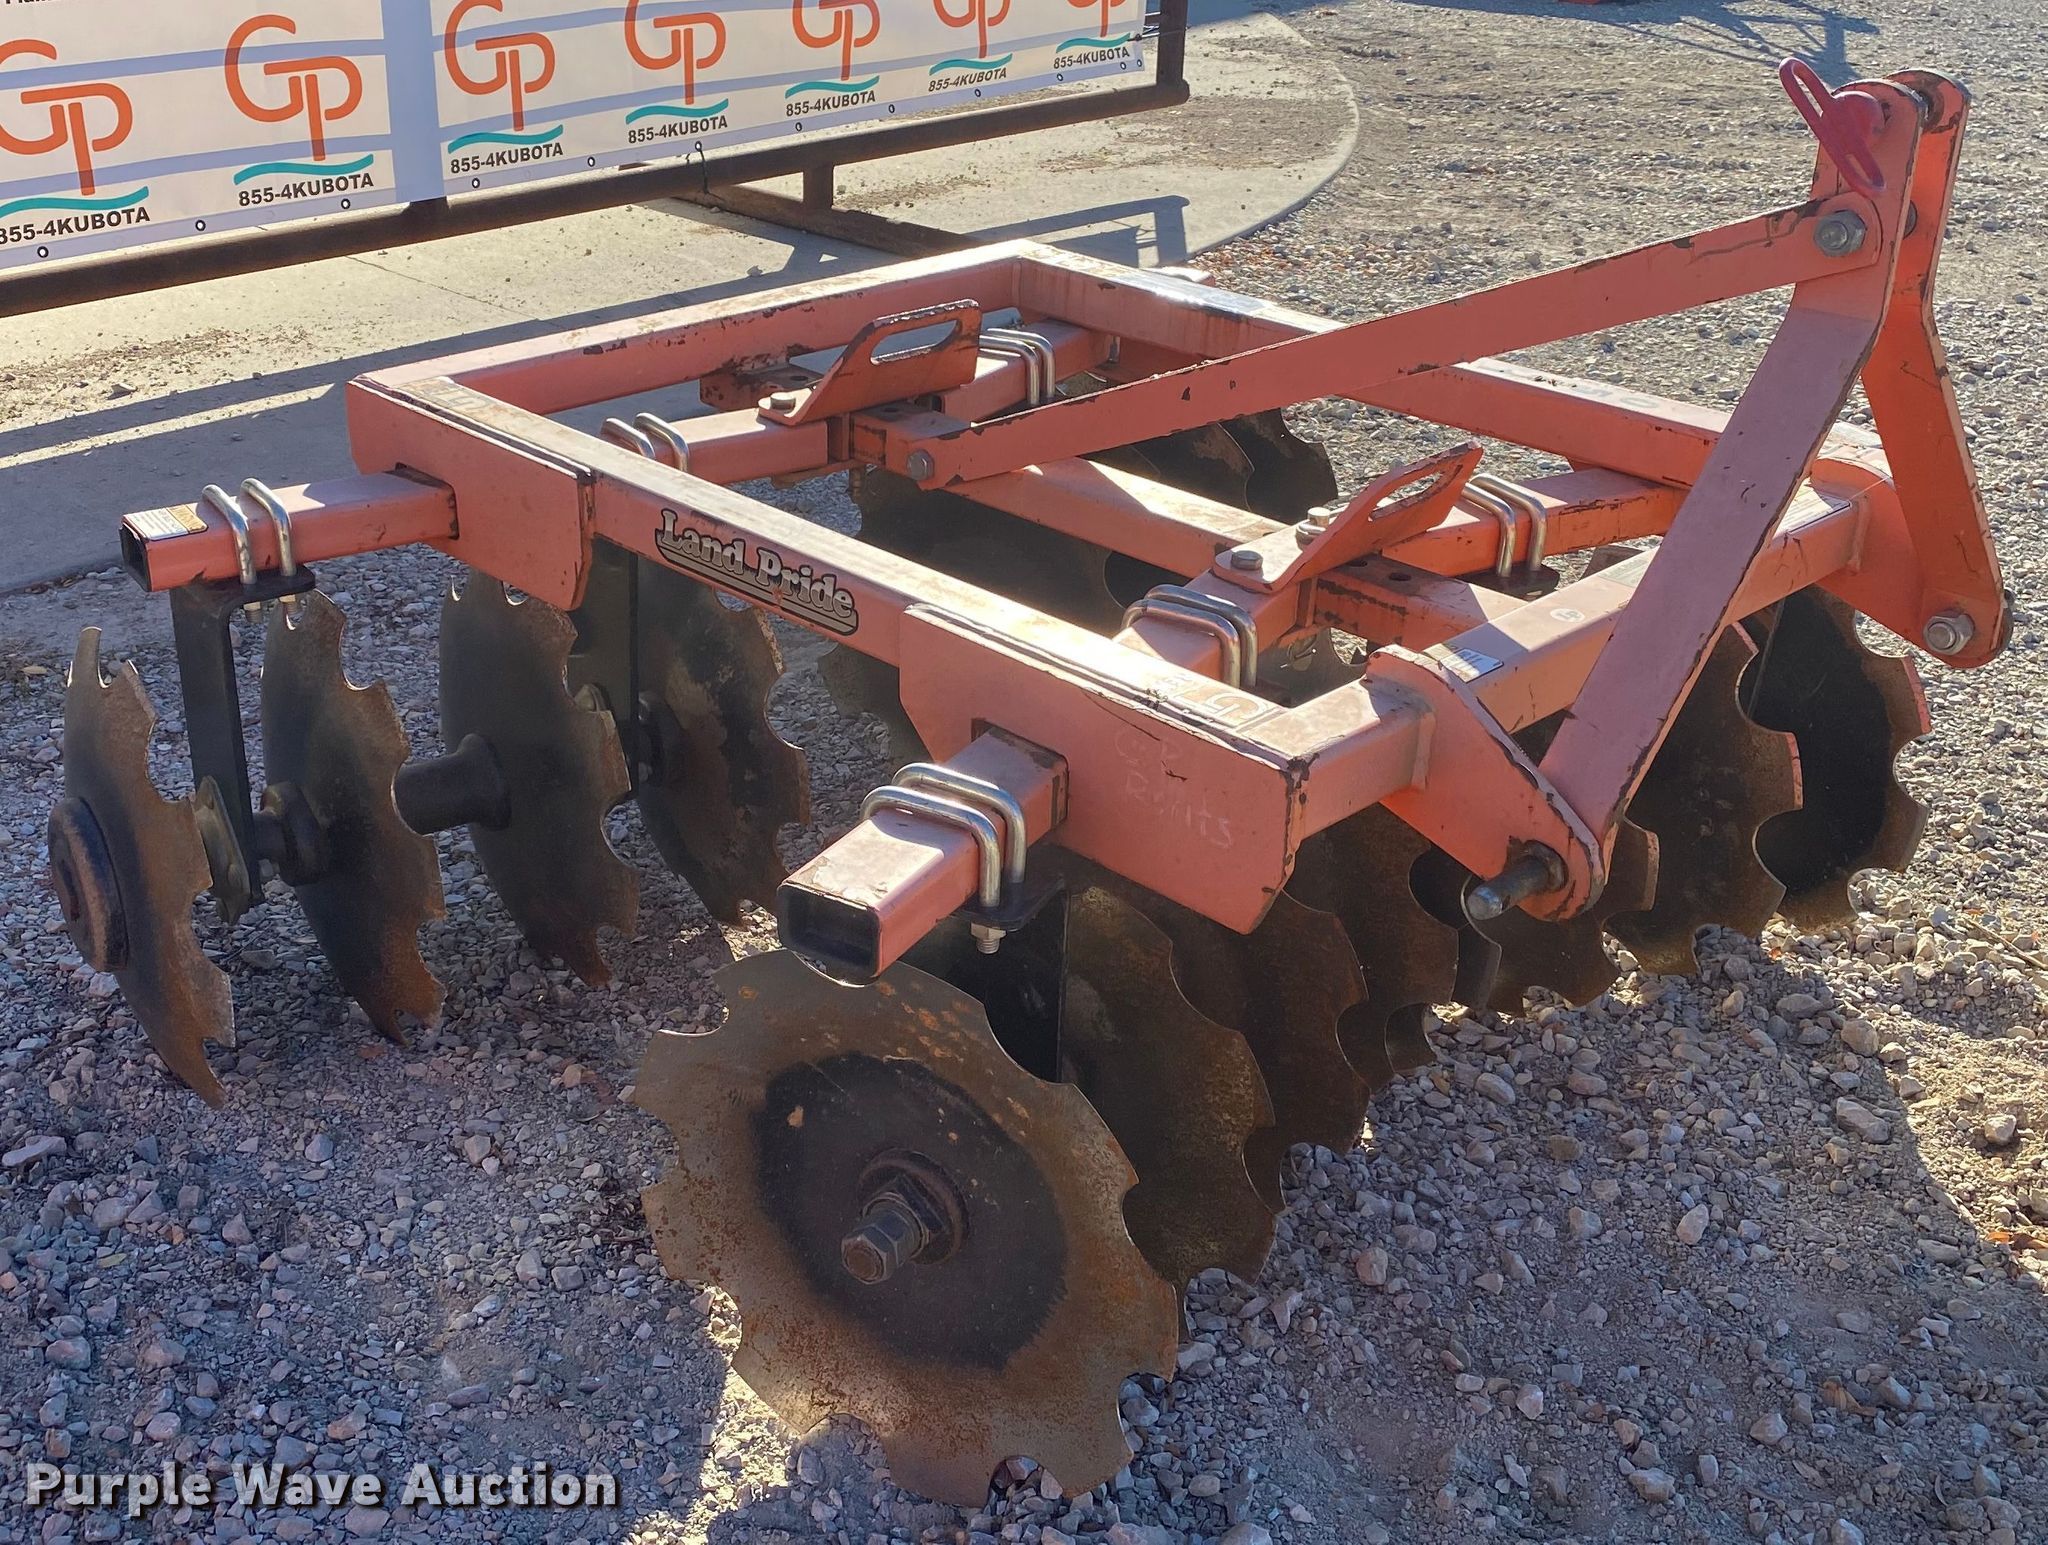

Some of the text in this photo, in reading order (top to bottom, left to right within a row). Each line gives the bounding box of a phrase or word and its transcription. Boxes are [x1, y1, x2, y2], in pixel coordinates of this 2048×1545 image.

[1053, 47, 1131, 70] 855-4KUBOTA
[928, 67, 1008, 92] 855-4KUBOTA
[785, 90, 877, 118] 855-4KUBOTA
[628, 115, 728, 144] 855-4KUBOTA
[450, 142, 564, 174] 855-4KUBOTA
[238, 172, 375, 207] 855-4KUBOTA
[660, 507, 855, 618] Land Pride
